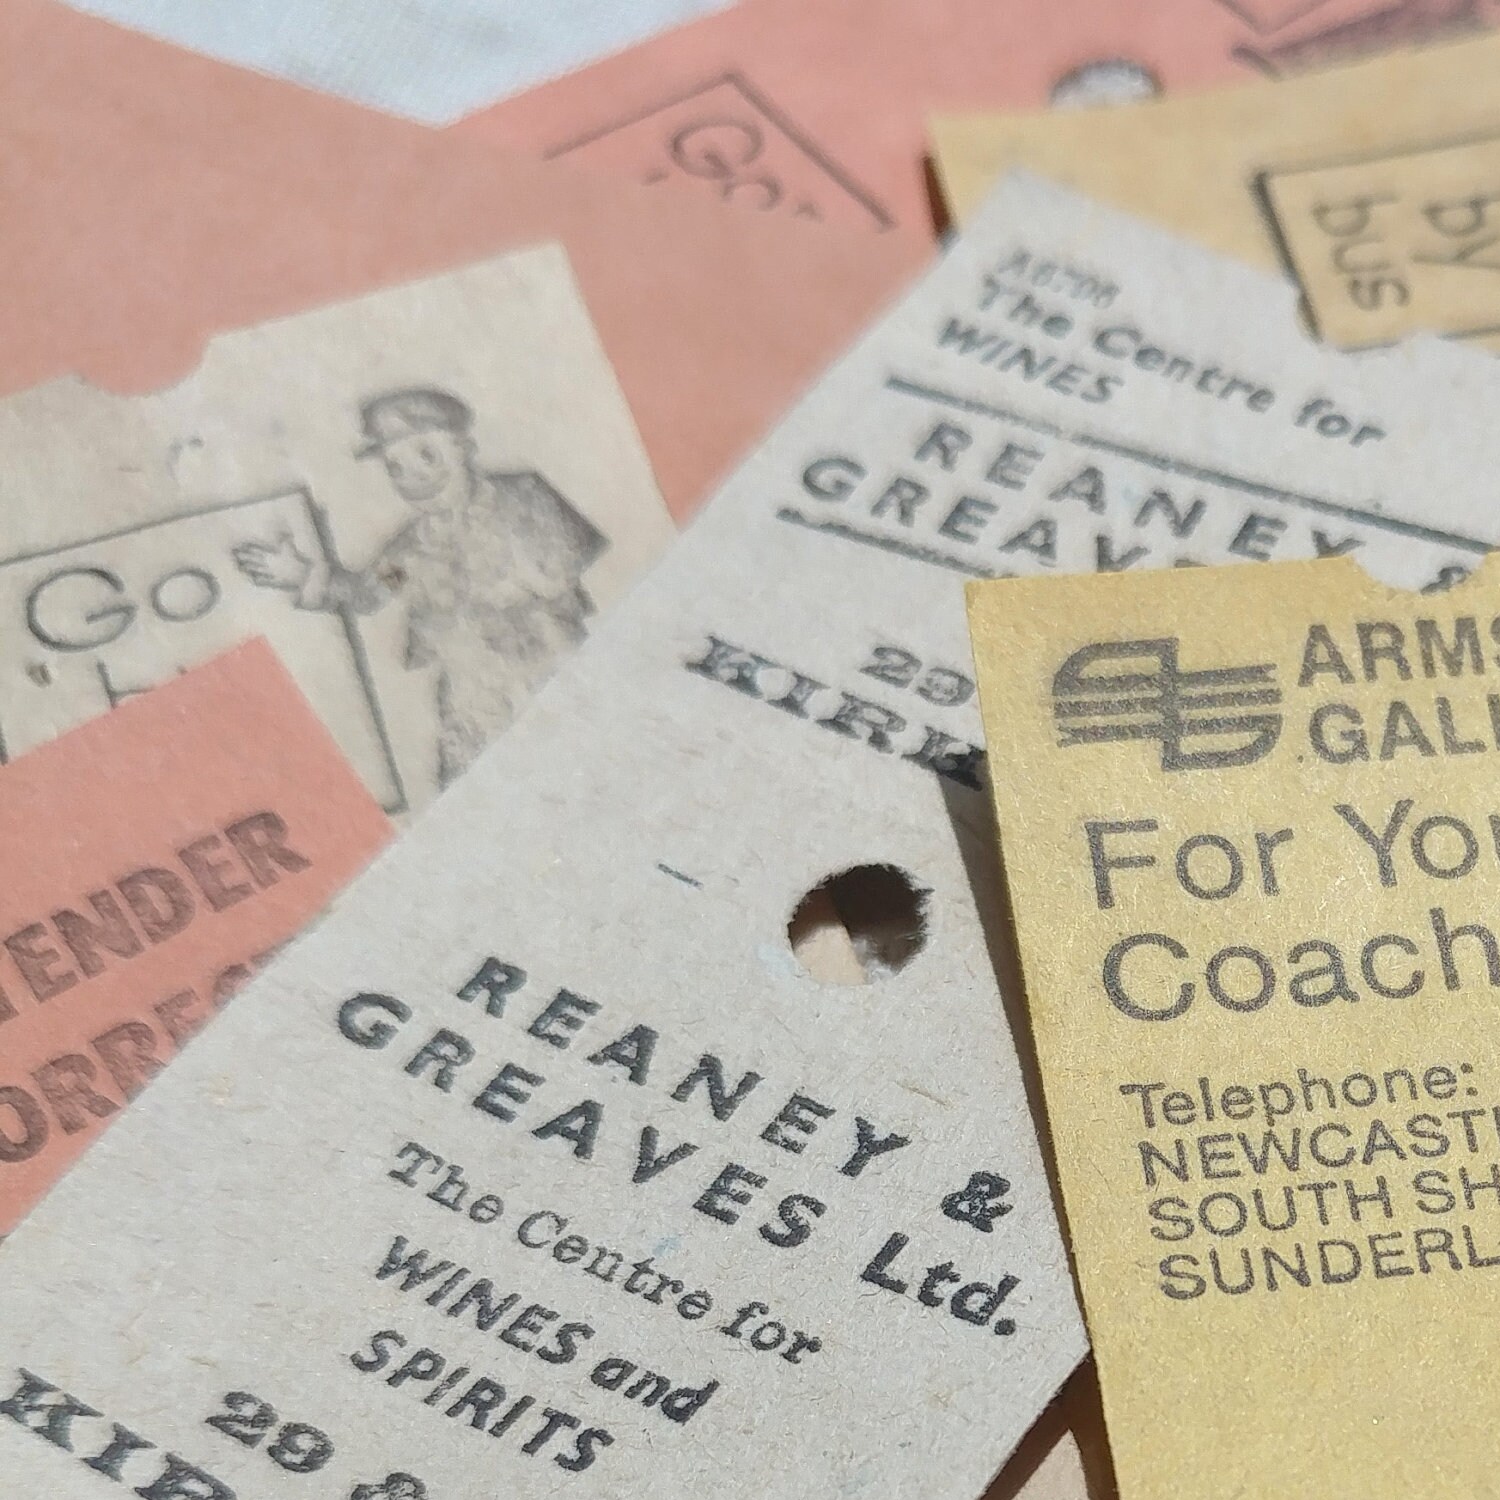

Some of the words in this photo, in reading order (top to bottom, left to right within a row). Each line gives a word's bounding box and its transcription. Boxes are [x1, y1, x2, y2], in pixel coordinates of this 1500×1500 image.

[1311, 190, 1411, 312] bus
[936, 316, 1124, 404] WINES
[977, 271, 1074, 338] The
[1093, 324, 1275, 413] Centre
[1293, 397, 1387, 448] for
[26, 566, 221, 653] Go
[859, 647, 976, 707] 29
[0, 811, 312, 1024] ENDER
[1084, 817, 1295, 910] For
[456, 956, 909, 1177] REANEY
[941, 1170, 1013, 1232] &
[1120, 1058, 1479, 1136] Telephone:
[337, 992, 827, 1248] GREAVES
[859, 1232, 1022, 1337] Ltd.
[1148, 1174, 1394, 1243] SOUTH
[387, 1142, 504, 1224] The
[517, 1209, 713, 1320] Centre
[720, 1300, 823, 1364] for
[374, 1234, 596, 1365] WINES
[591, 1355, 720, 1425] and
[205, 1391, 335, 1473] 29
[350, 1329, 614, 1472] SPIRITS
